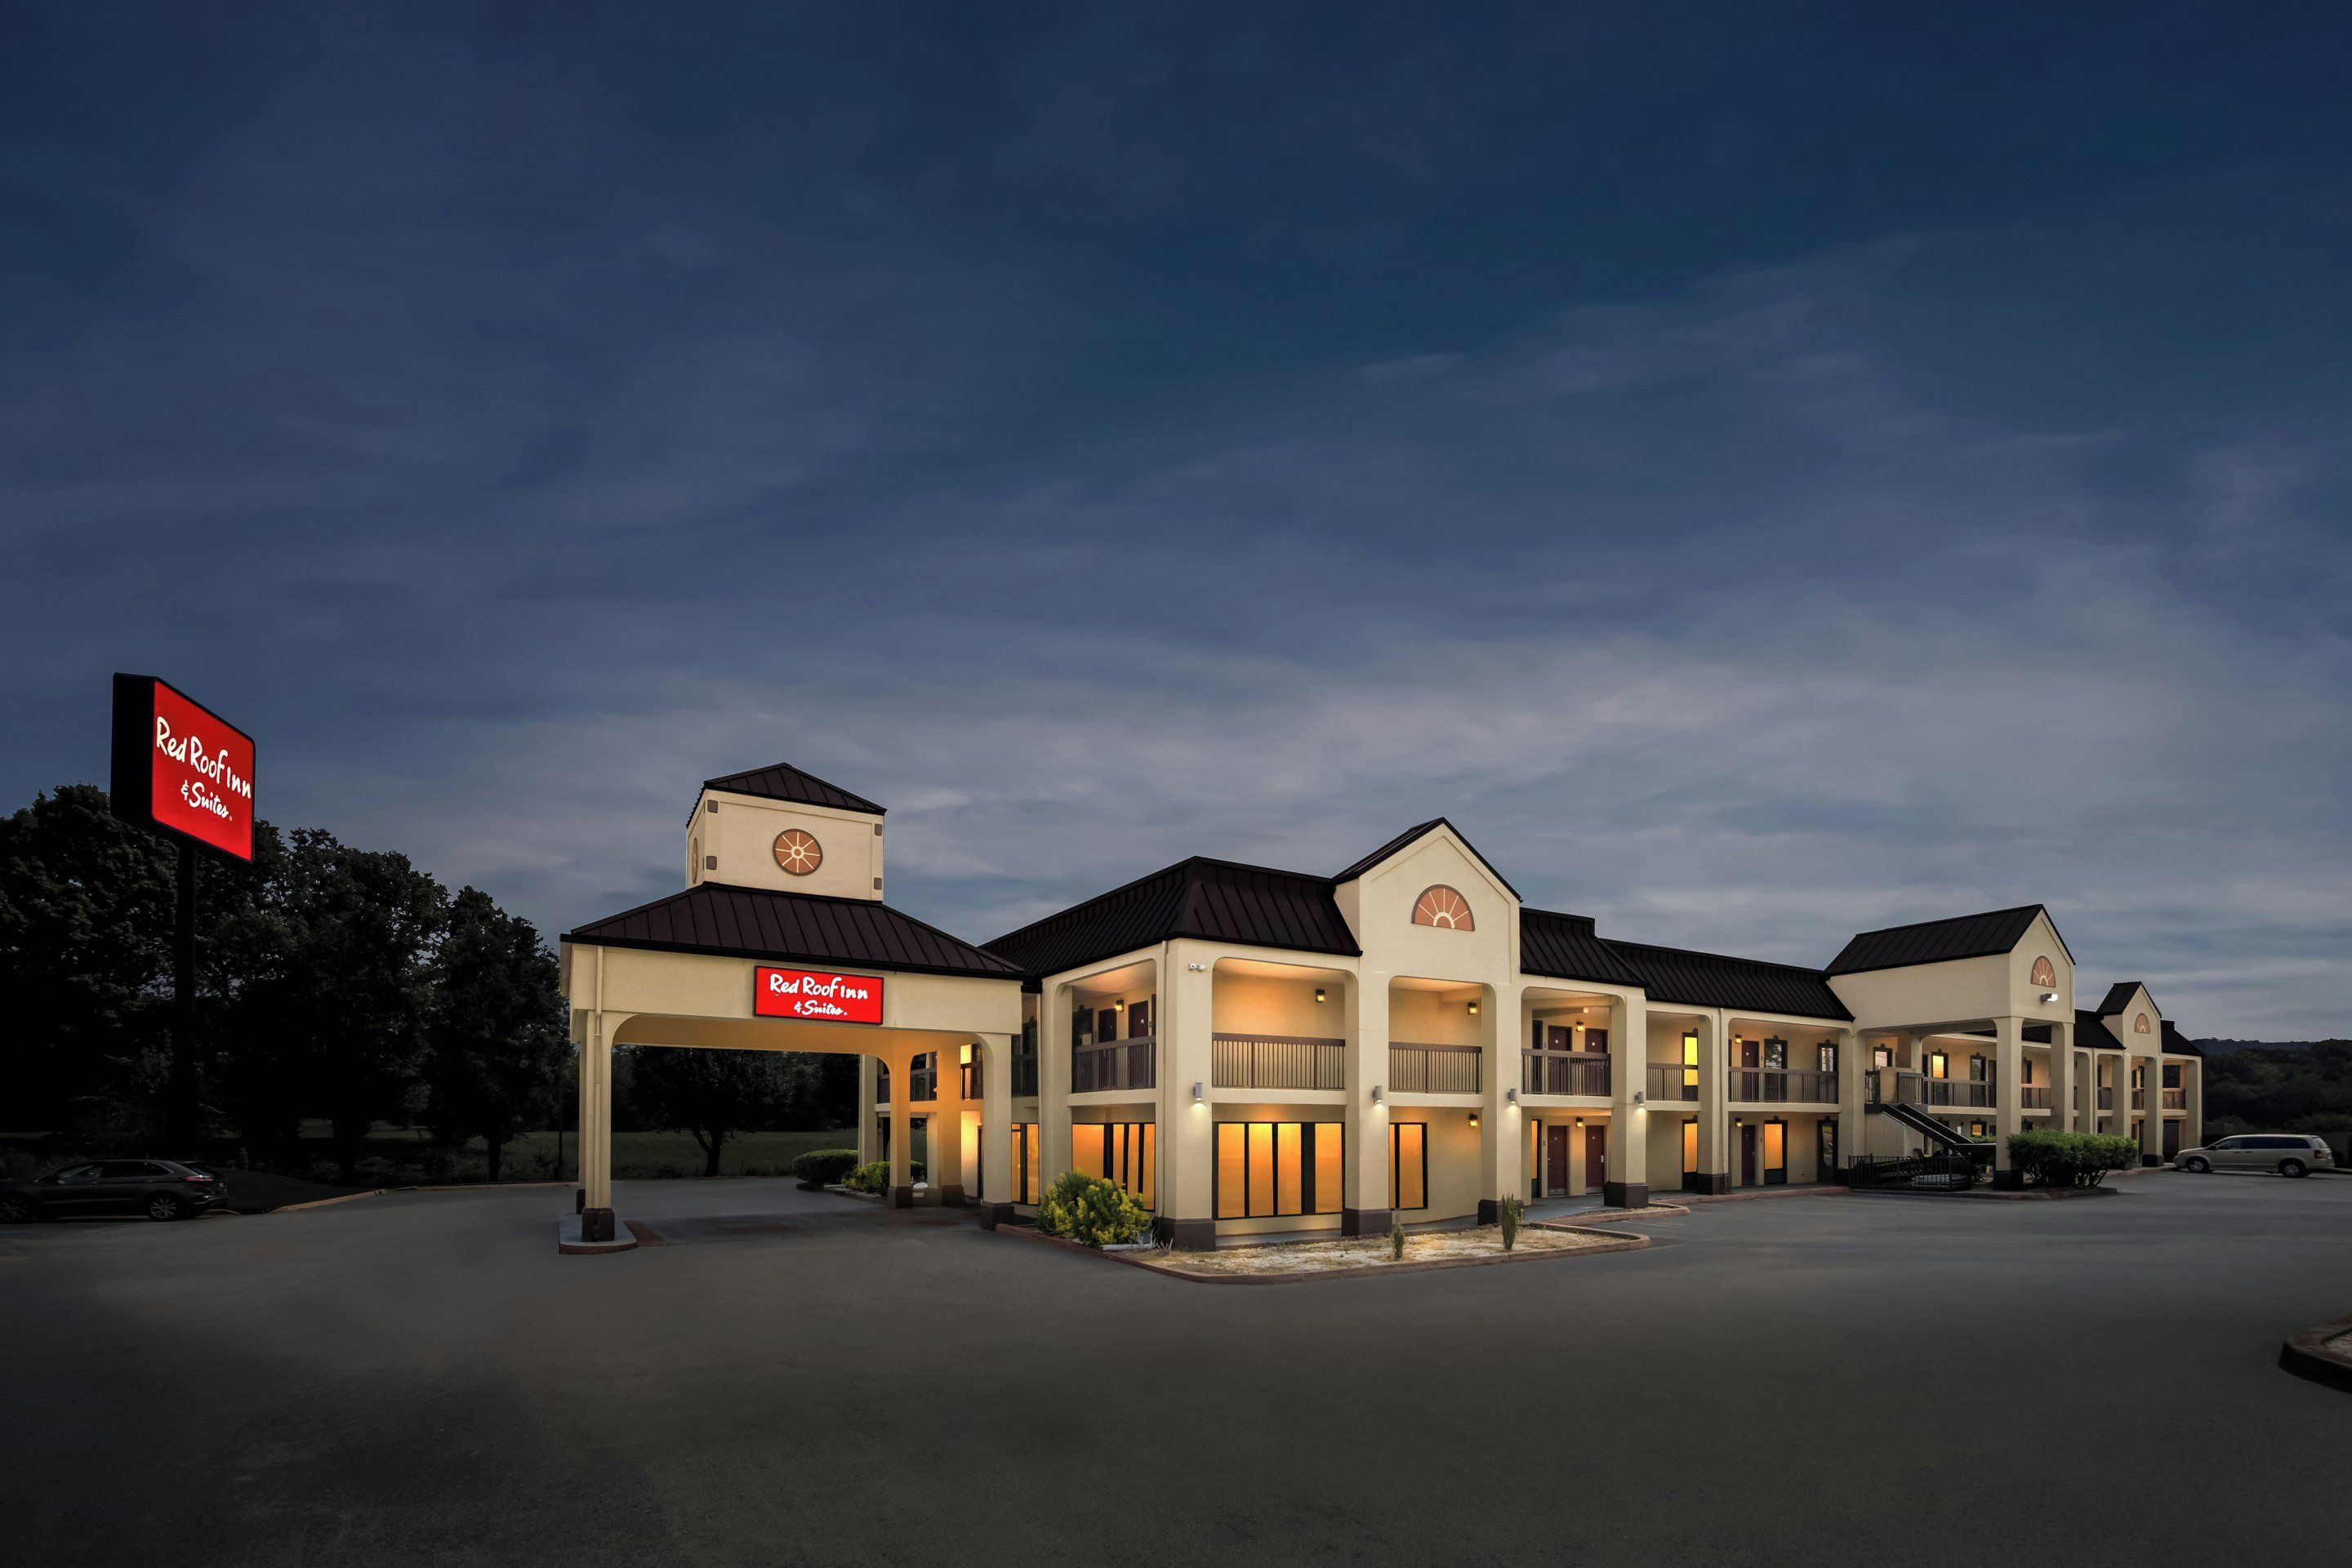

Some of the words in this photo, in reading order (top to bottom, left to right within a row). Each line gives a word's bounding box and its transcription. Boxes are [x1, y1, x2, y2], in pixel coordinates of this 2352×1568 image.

[156, 716, 187, 763] Red
[190, 736, 229, 784] Roof
[227, 767, 252, 799] Inn
[180, 779, 189, 800] &
[770, 973, 800, 994] Red
[802, 976, 842, 998] Roof
[840, 985, 868, 1000] Inn
[793, 1001, 802, 1013] &
